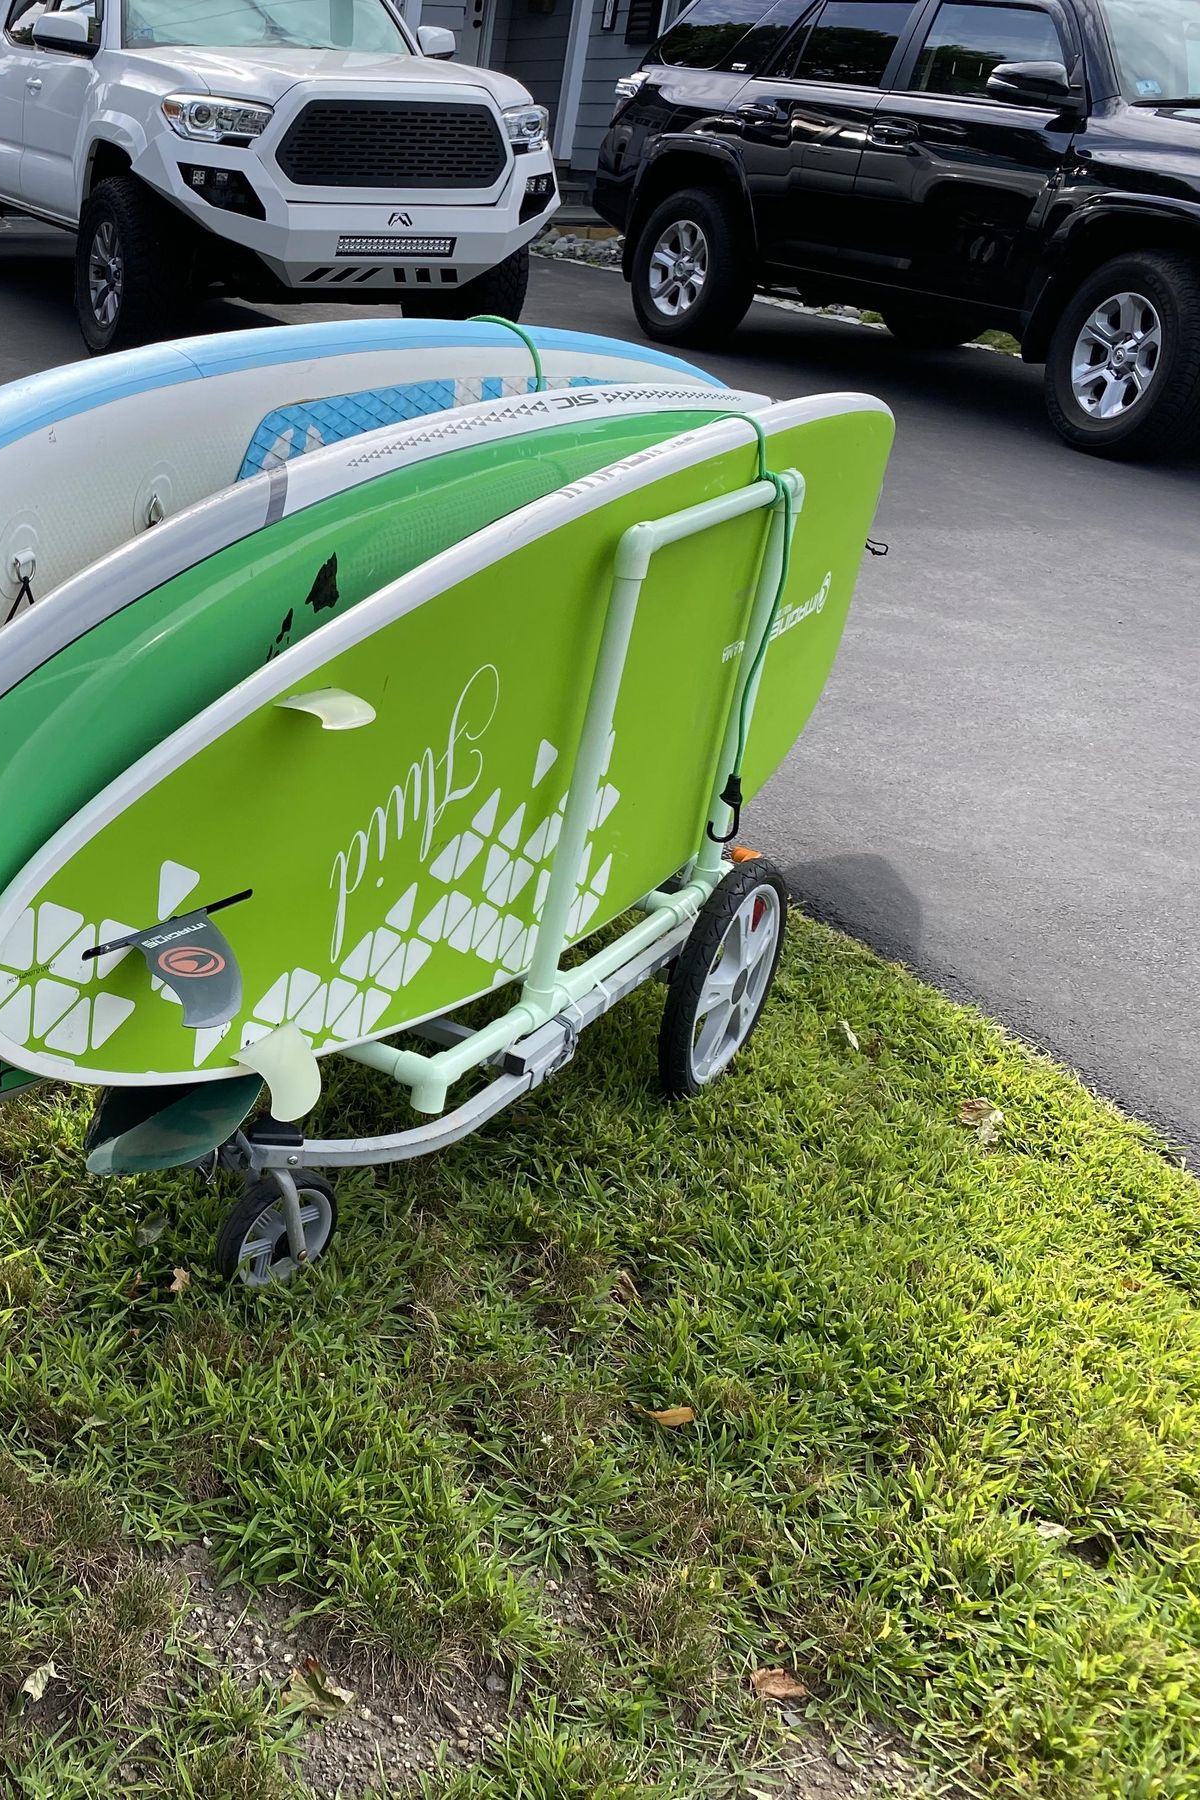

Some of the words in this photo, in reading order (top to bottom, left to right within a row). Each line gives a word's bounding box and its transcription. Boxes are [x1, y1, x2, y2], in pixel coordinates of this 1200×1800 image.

[550, 391, 605, 411] SIC
[329, 663, 499, 965] Fluid
[142, 921, 208, 950] IMAGINE
